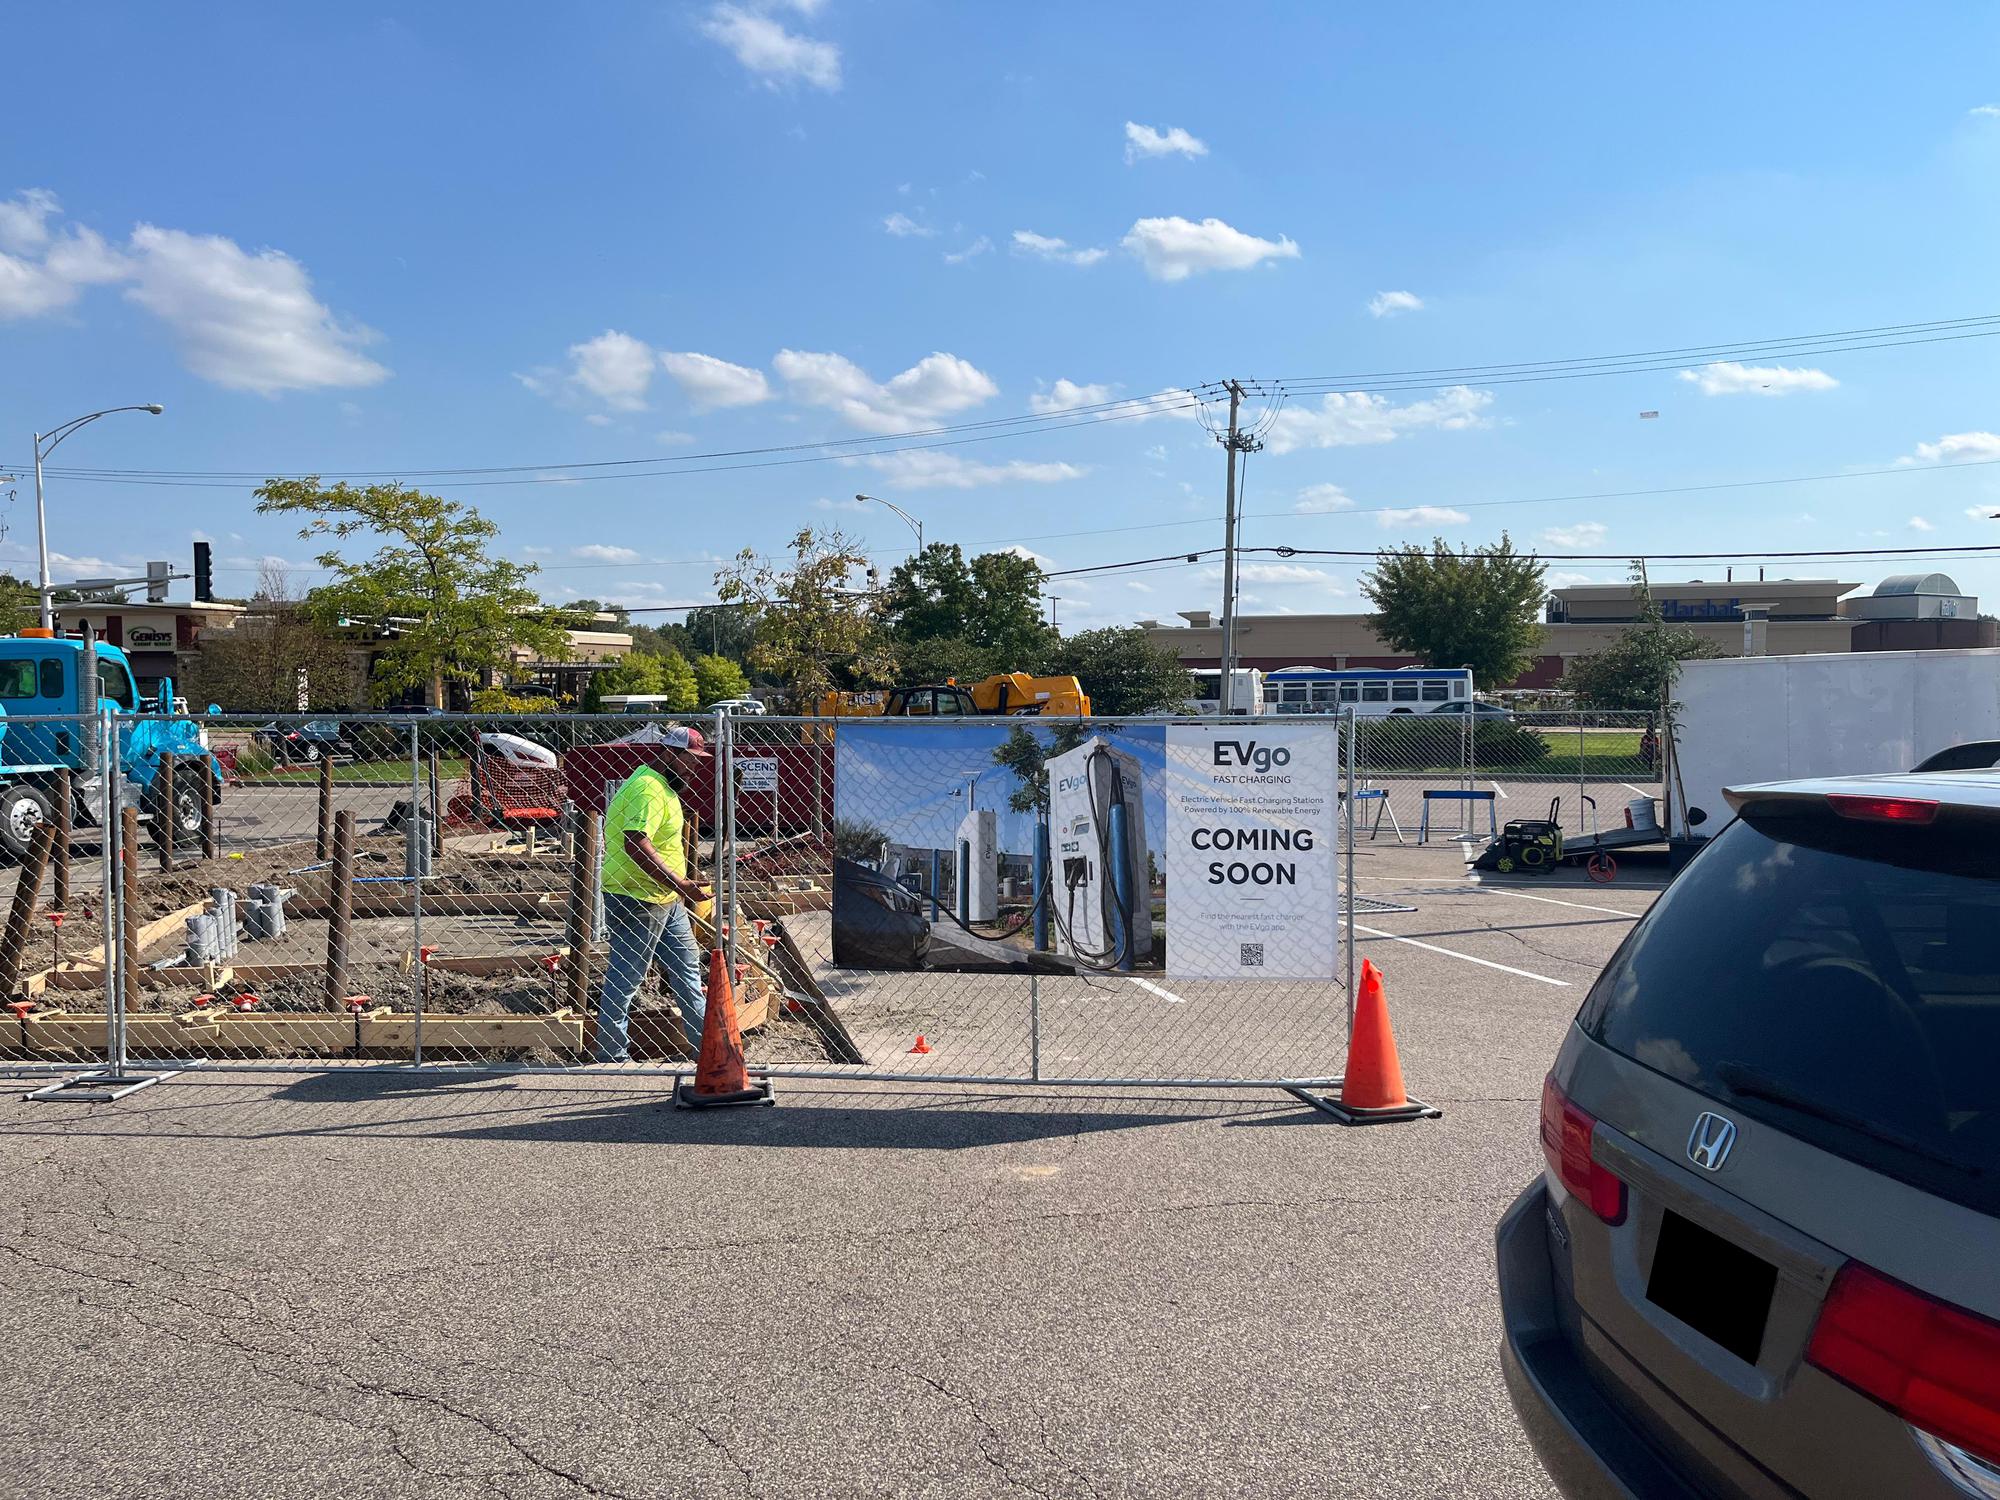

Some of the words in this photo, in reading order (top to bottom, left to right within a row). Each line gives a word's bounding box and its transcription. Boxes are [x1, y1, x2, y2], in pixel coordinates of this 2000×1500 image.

[1664, 598, 1741, 617] Marshall
[1214, 741, 1291, 773] EVgo
[1060, 774, 1087, 792] EVgo
[1213, 775, 1237, 784] FAST
[1239, 775, 1291, 784] CHARGING
[1181, 795, 1209, 803] Electric
[1239, 796, 1256, 804] Fast
[1257, 796, 1292, 806] Charging
[1293, 796, 1324, 804] Stations
[1218, 806, 1228, 815] by
[1229, 806, 1250, 814] 100%
[1252, 807, 1293, 815] Renewable
[1295, 807, 1321, 816] Energy
[1191, 828, 1313, 851] COMING
[1208, 862, 1296, 885] SOON
[1201, 912, 1216, 920] Find
[1275, 913, 1304, 922] charger
[1250, 924, 1270, 932] EVgo
